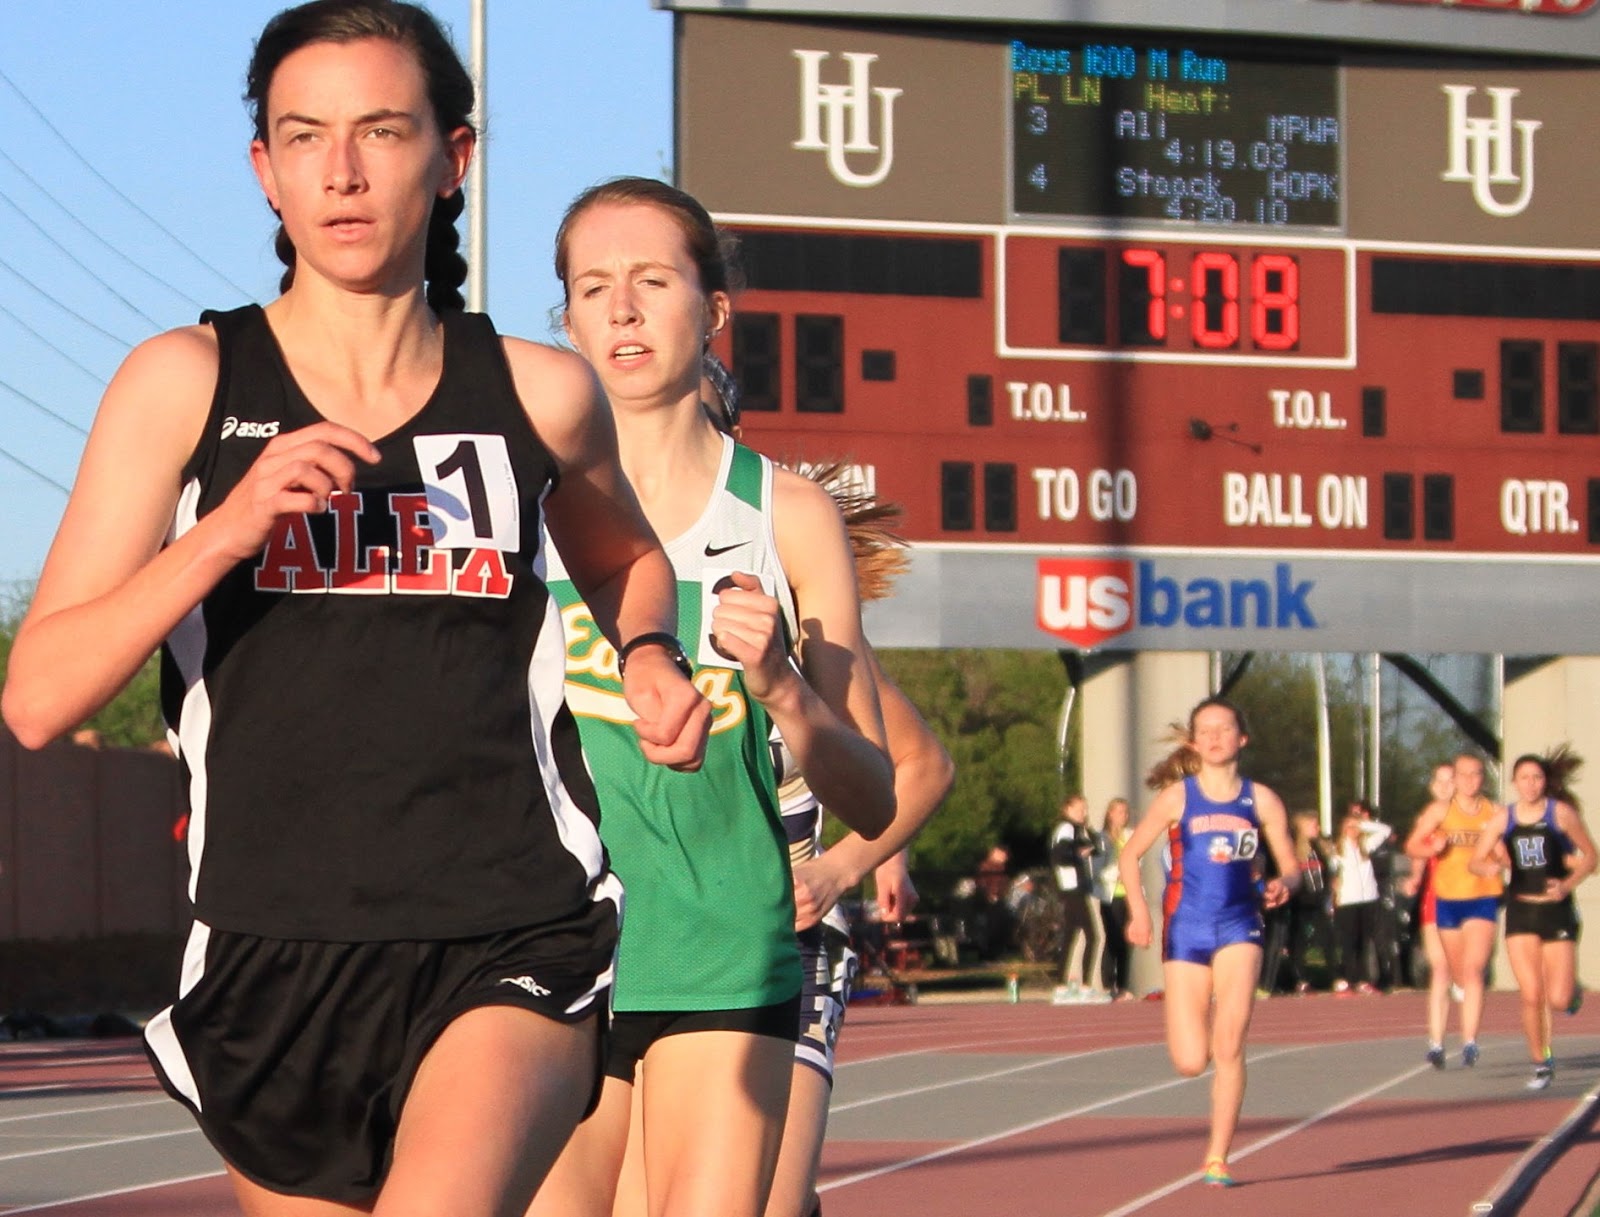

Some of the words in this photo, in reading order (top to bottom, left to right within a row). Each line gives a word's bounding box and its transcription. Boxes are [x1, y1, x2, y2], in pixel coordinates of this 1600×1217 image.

[1009, 40, 1071, 75] Boys
[1085, 45, 1136, 79] 1600
[1147, 49, 1168, 80] M
[1180, 48, 1228, 83] Run
[1013, 73, 1050, 103] PL
[1063, 75, 1101, 105] LN
[1029, 106, 1048, 135] 3
[1163, 138, 1287, 170] 4:19.03
[1029, 163, 1048, 191] 4
[1267, 171, 1339, 200] HOPK
[1121, 248, 1298, 350] 7:08
[1007, 382, 1087, 422] T.O.L.
[1269, 389, 1347, 429] T.O.L.
[236, 421, 280, 438] asics
[436, 440, 493, 539] 1
[1033, 468, 1079, 521] TO
[1087, 468, 1138, 522] GO
[1223, 472, 1312, 528] BALL
[1317, 474, 1368, 529] ON
[1501, 478, 1580, 535] QTR.
[1238, 830, 1255, 858] 6
[1517, 836, 1548, 867] H
